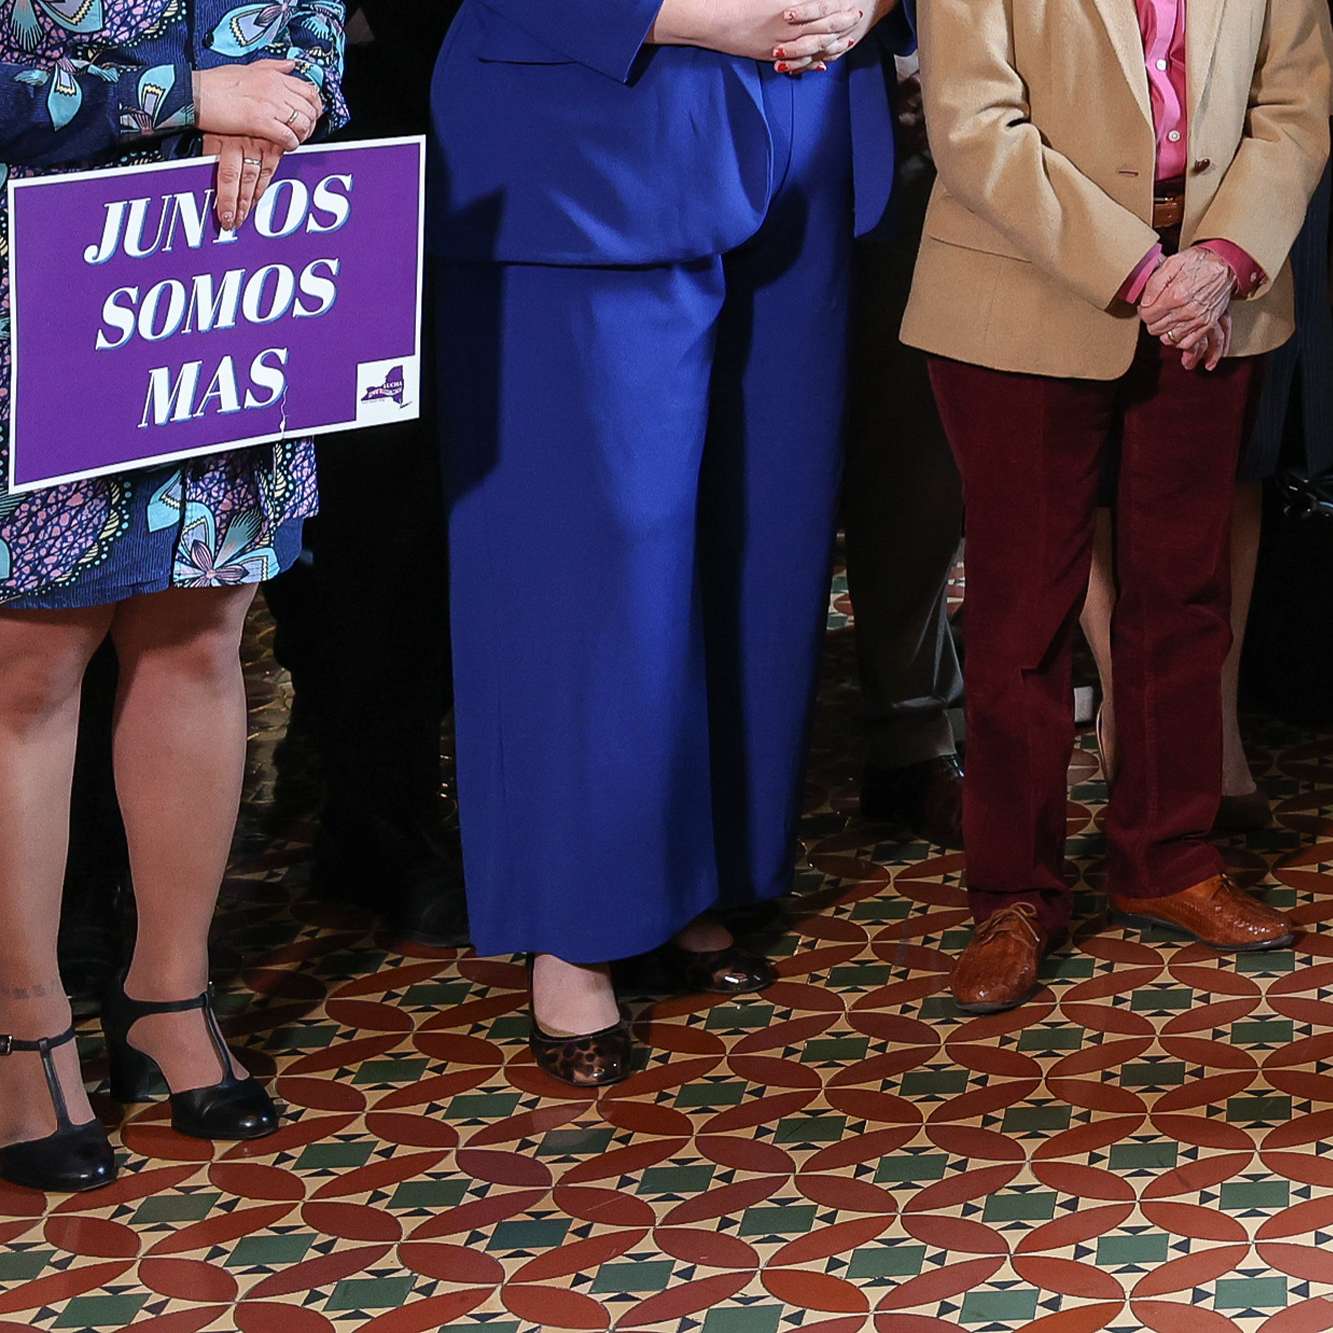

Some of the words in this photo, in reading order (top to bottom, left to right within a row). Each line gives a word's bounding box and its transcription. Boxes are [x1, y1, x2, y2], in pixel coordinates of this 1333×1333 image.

[84, 174, 353, 264] JUNOS
[95, 257, 341, 350] SOMOS
[137, 347, 288, 428] MAS
